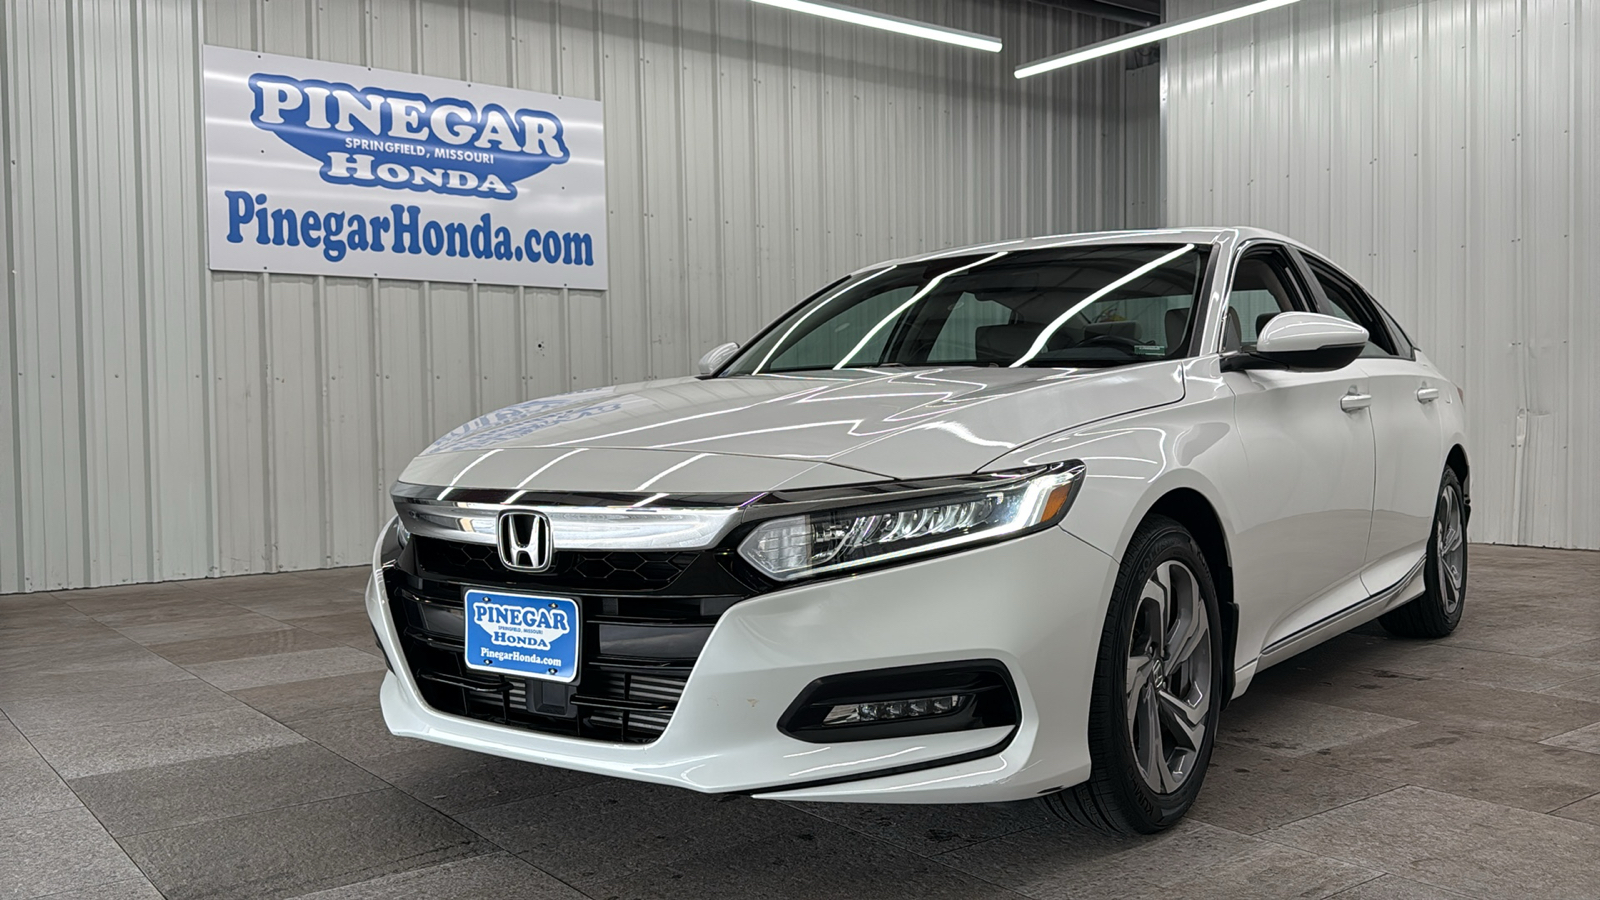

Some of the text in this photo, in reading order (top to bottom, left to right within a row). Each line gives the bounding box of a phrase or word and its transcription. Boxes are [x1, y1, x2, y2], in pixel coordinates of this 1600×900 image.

[255, 80, 564, 158] PINEGAR
[344, 137, 494, 164] SPRINGFIELD, MISSOURI
[225, 190, 594, 266] PinegarHonda.com
[475, 605, 567, 630] PINEGAR
[498, 625, 522, 633] SPRINGFIELD,
[480, 647, 561, 666] PinegarHonda.com
